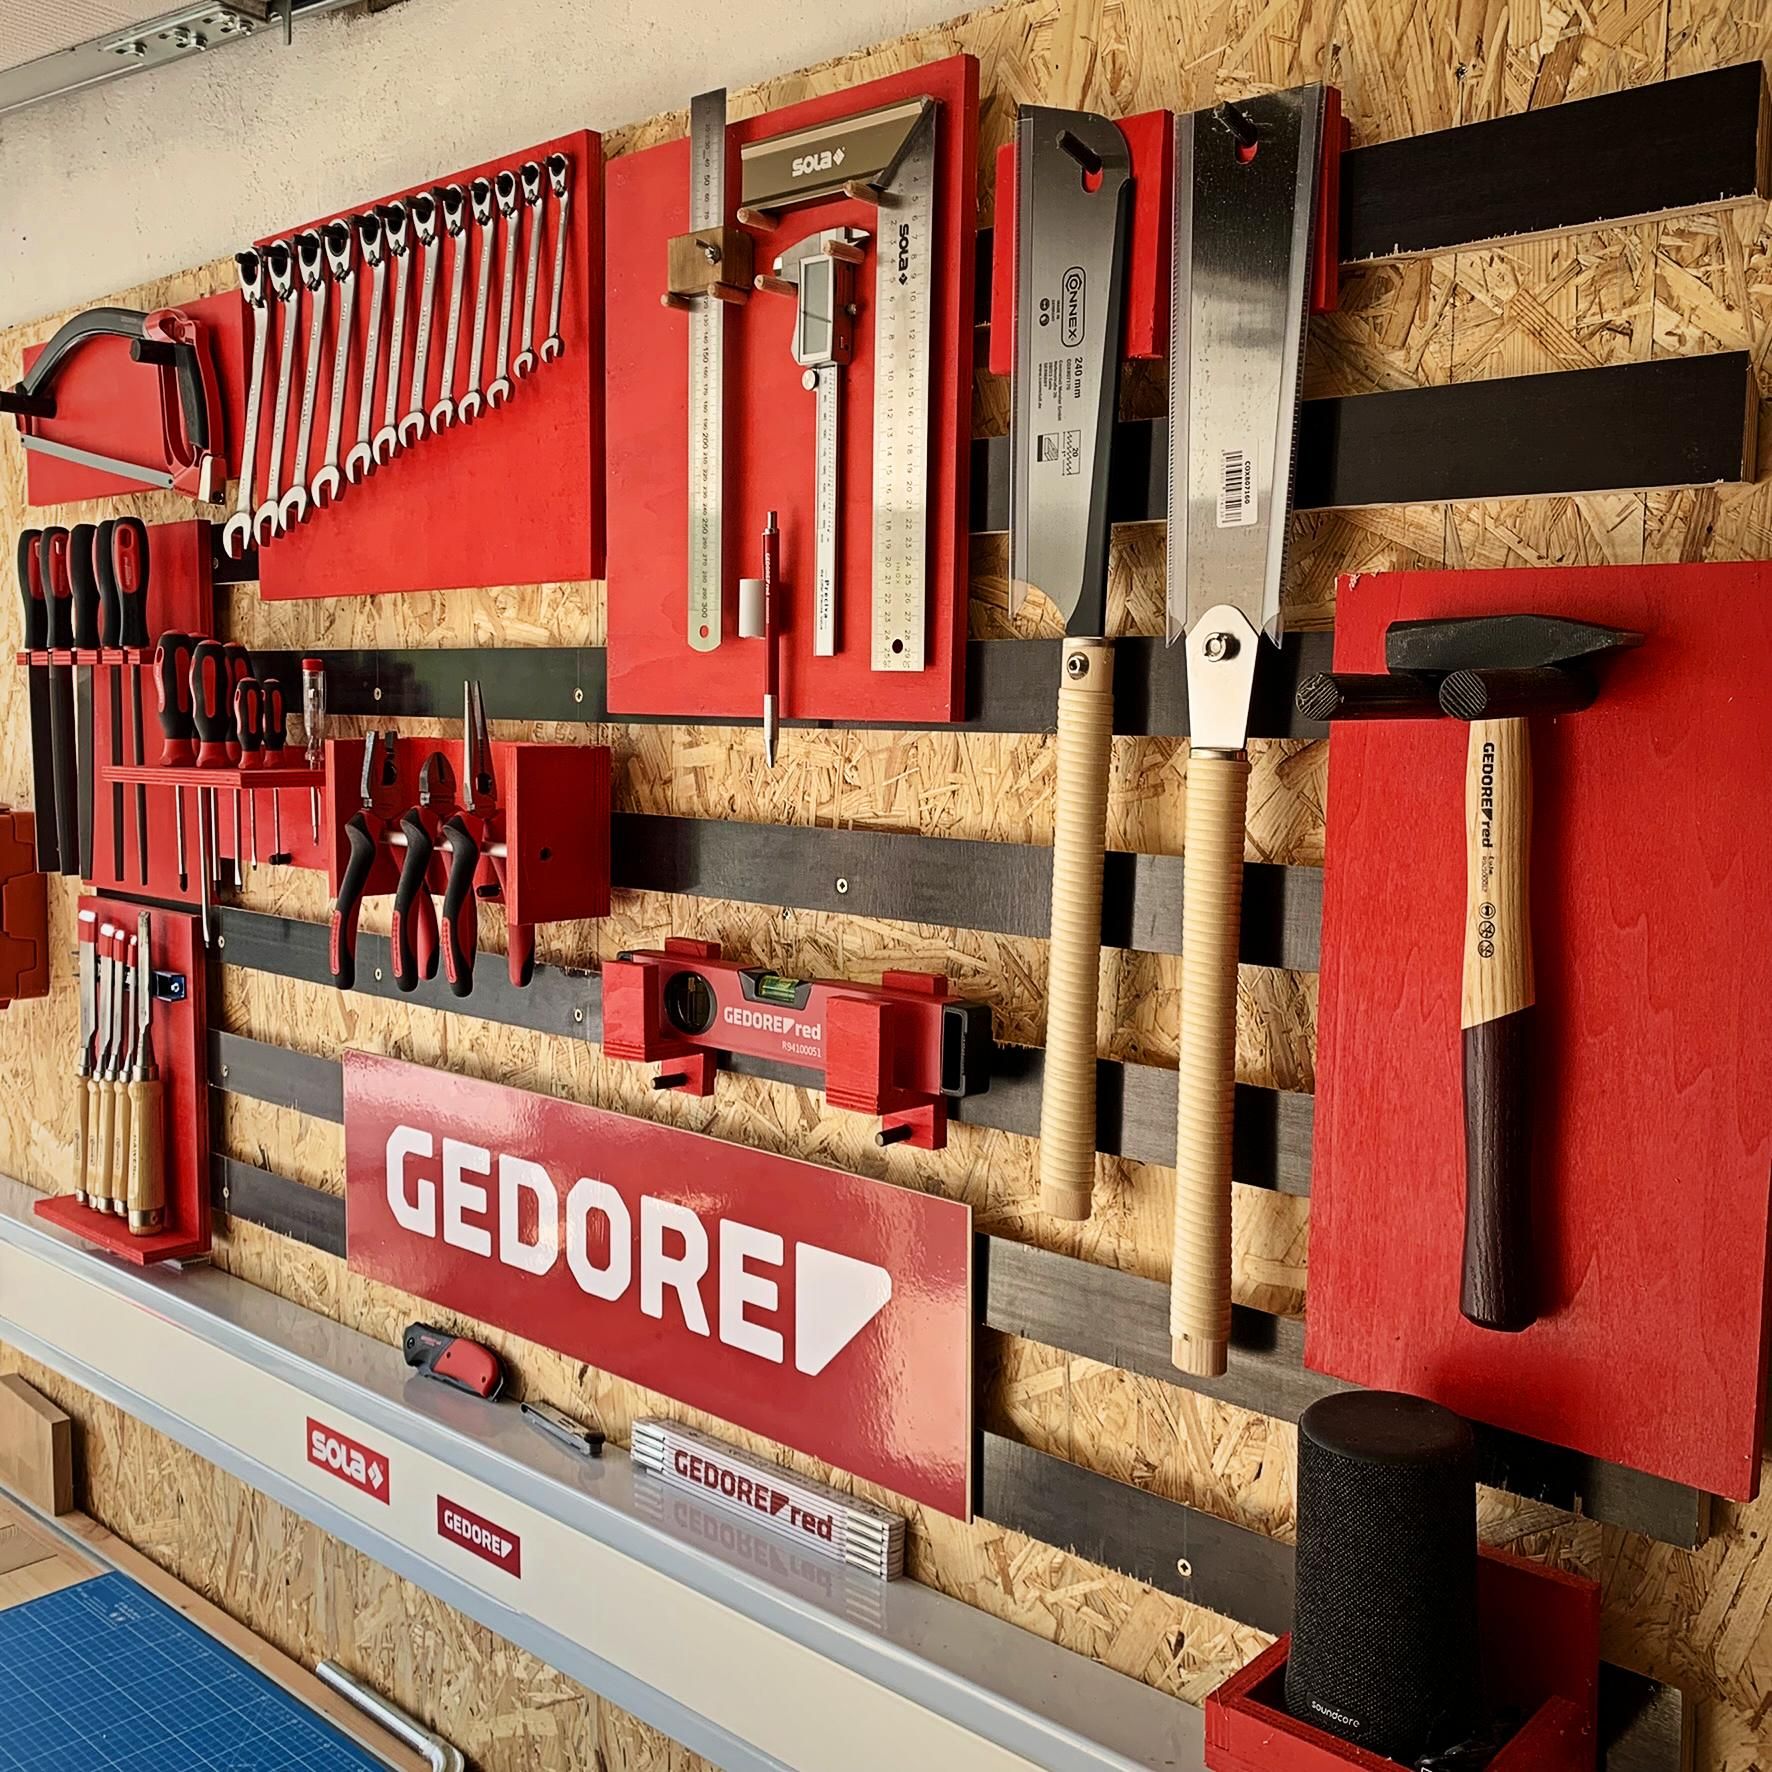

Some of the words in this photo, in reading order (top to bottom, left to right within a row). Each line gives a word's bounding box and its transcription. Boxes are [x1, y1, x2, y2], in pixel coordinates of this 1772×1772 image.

[704, 174, 710, 186] 50
[910, 291, 916, 302] 10
[910, 310, 916, 319] 11
[909, 329, 915, 339] 12
[909, 348, 915, 359] 13
[1075, 357, 1083, 376] 240
[888, 370, 894, 381] 10
[909, 368, 914, 378] 14
[888, 389, 893, 399] 11
[908, 386, 914, 398] 15
[1074, 379, 1081, 398] mm
[887, 408, 893, 418] 12
[908, 406, 914, 416] 16
[887, 427, 893, 438] 13
[908, 425, 913, 435] 17
[887, 446, 892, 456] 14
[1072, 448, 1079, 457] 20
[907, 481, 912, 492] 20
[886, 502, 892, 512] 17
[906, 500, 912, 510] 21
[906, 519, 912, 530] 22
[905, 537, 912, 548] 23
[885, 556, 891, 568] 20
[905, 556, 912, 566] 24
[885, 575, 891, 585] 21
[905, 574, 911, 585] 25
[885, 593, 891, 604] 22
[905, 593, 911, 604] 26
[885, 612, 891, 622] 23
[905, 611, 911, 622] 27
[905, 630, 911, 640] 28
[1481, 742, 1495, 807] GEDORE
[1482, 820, 1493, 848] red
[724, 1006, 782, 1034] GEDORE
[795, 1024, 822, 1040] red
[385, 1124, 784, 1364] GEDORE
[674, 1449, 769, 1514] GEDORE
[790, 1505, 832, 1542] red
[444, 1509, 501, 1556] GEDORE
[1311, 1700, 1360, 1728] soundcore
